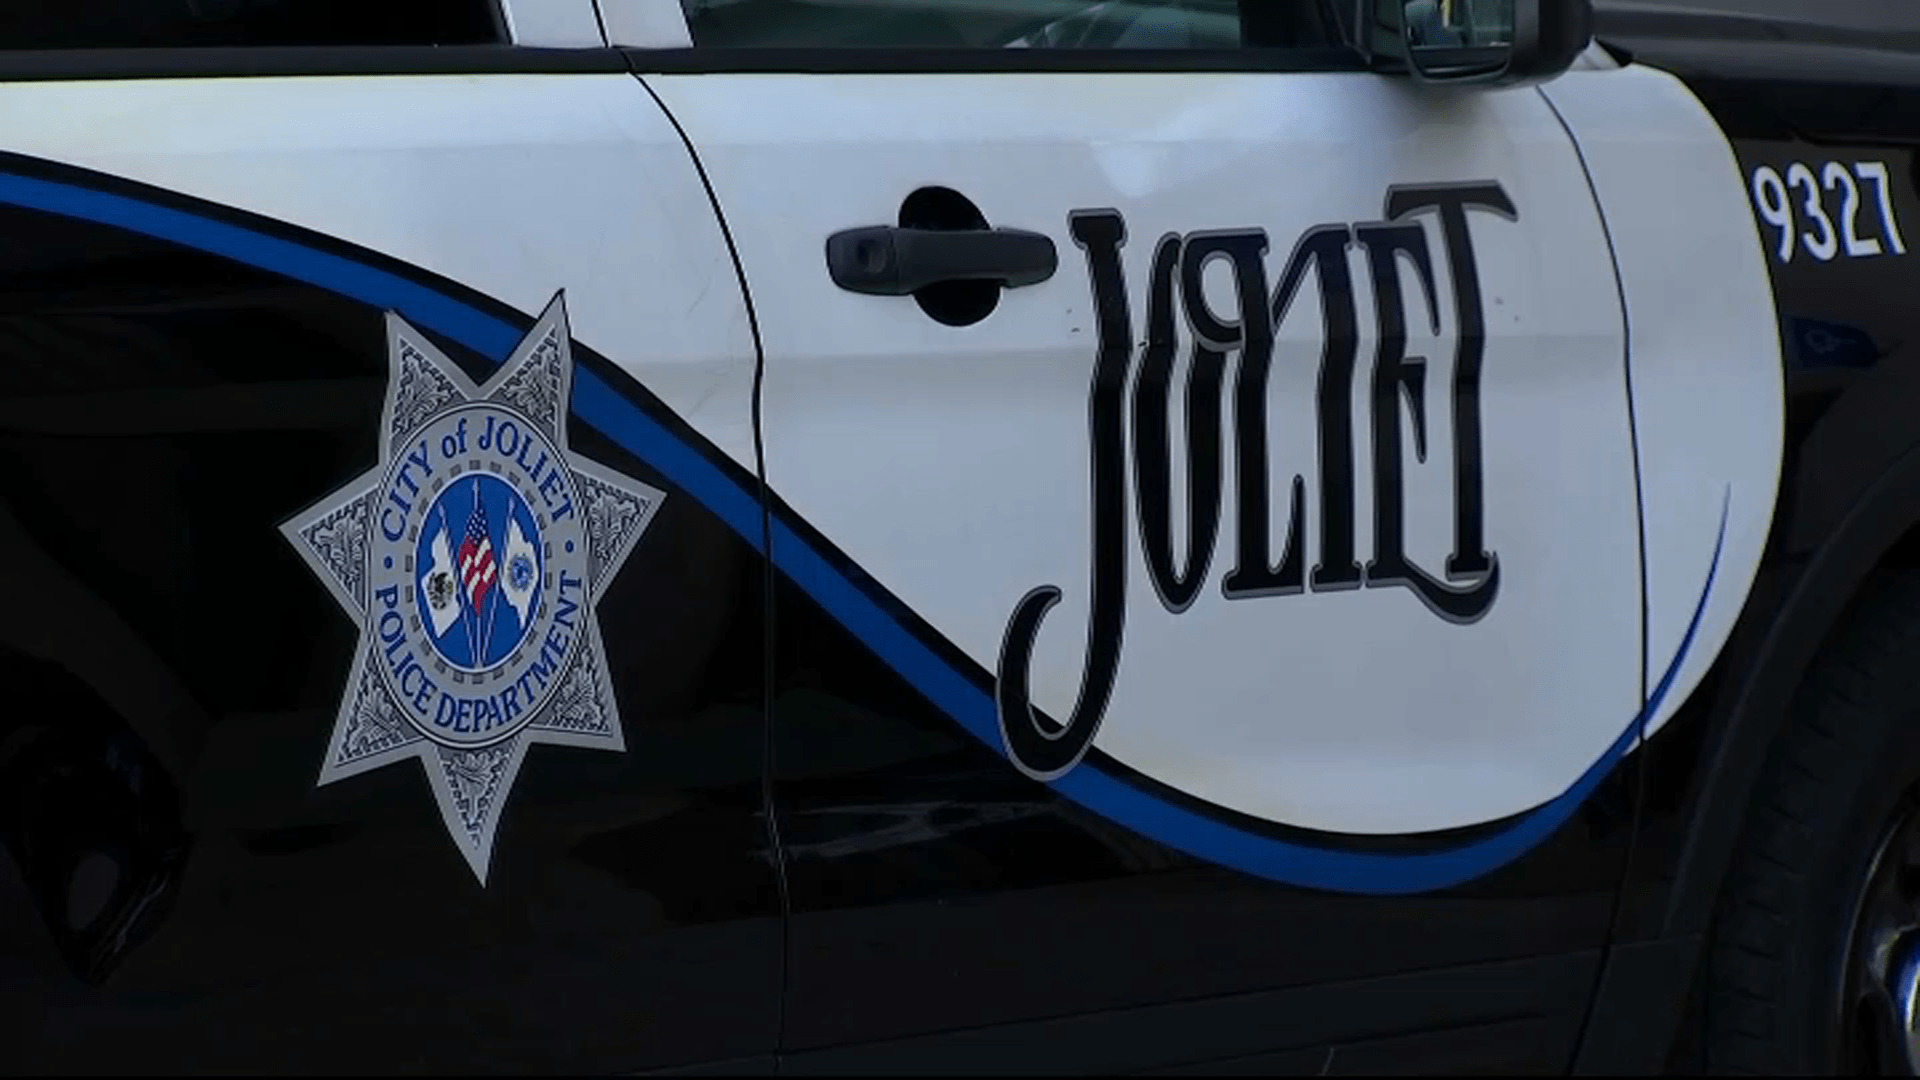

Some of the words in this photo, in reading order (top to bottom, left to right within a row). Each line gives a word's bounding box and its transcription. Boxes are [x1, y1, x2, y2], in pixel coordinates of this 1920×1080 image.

[1753, 160, 1906, 263] 9327
[380, 440, 433, 542] CITY
[441, 417, 468, 459] of
[478, 415, 574, 522] JOLIET
[996, 180, 1518, 781] JOLIET
[375, 584, 437, 715] POLICE
[434, 570, 582, 733] DEPARTMENT
